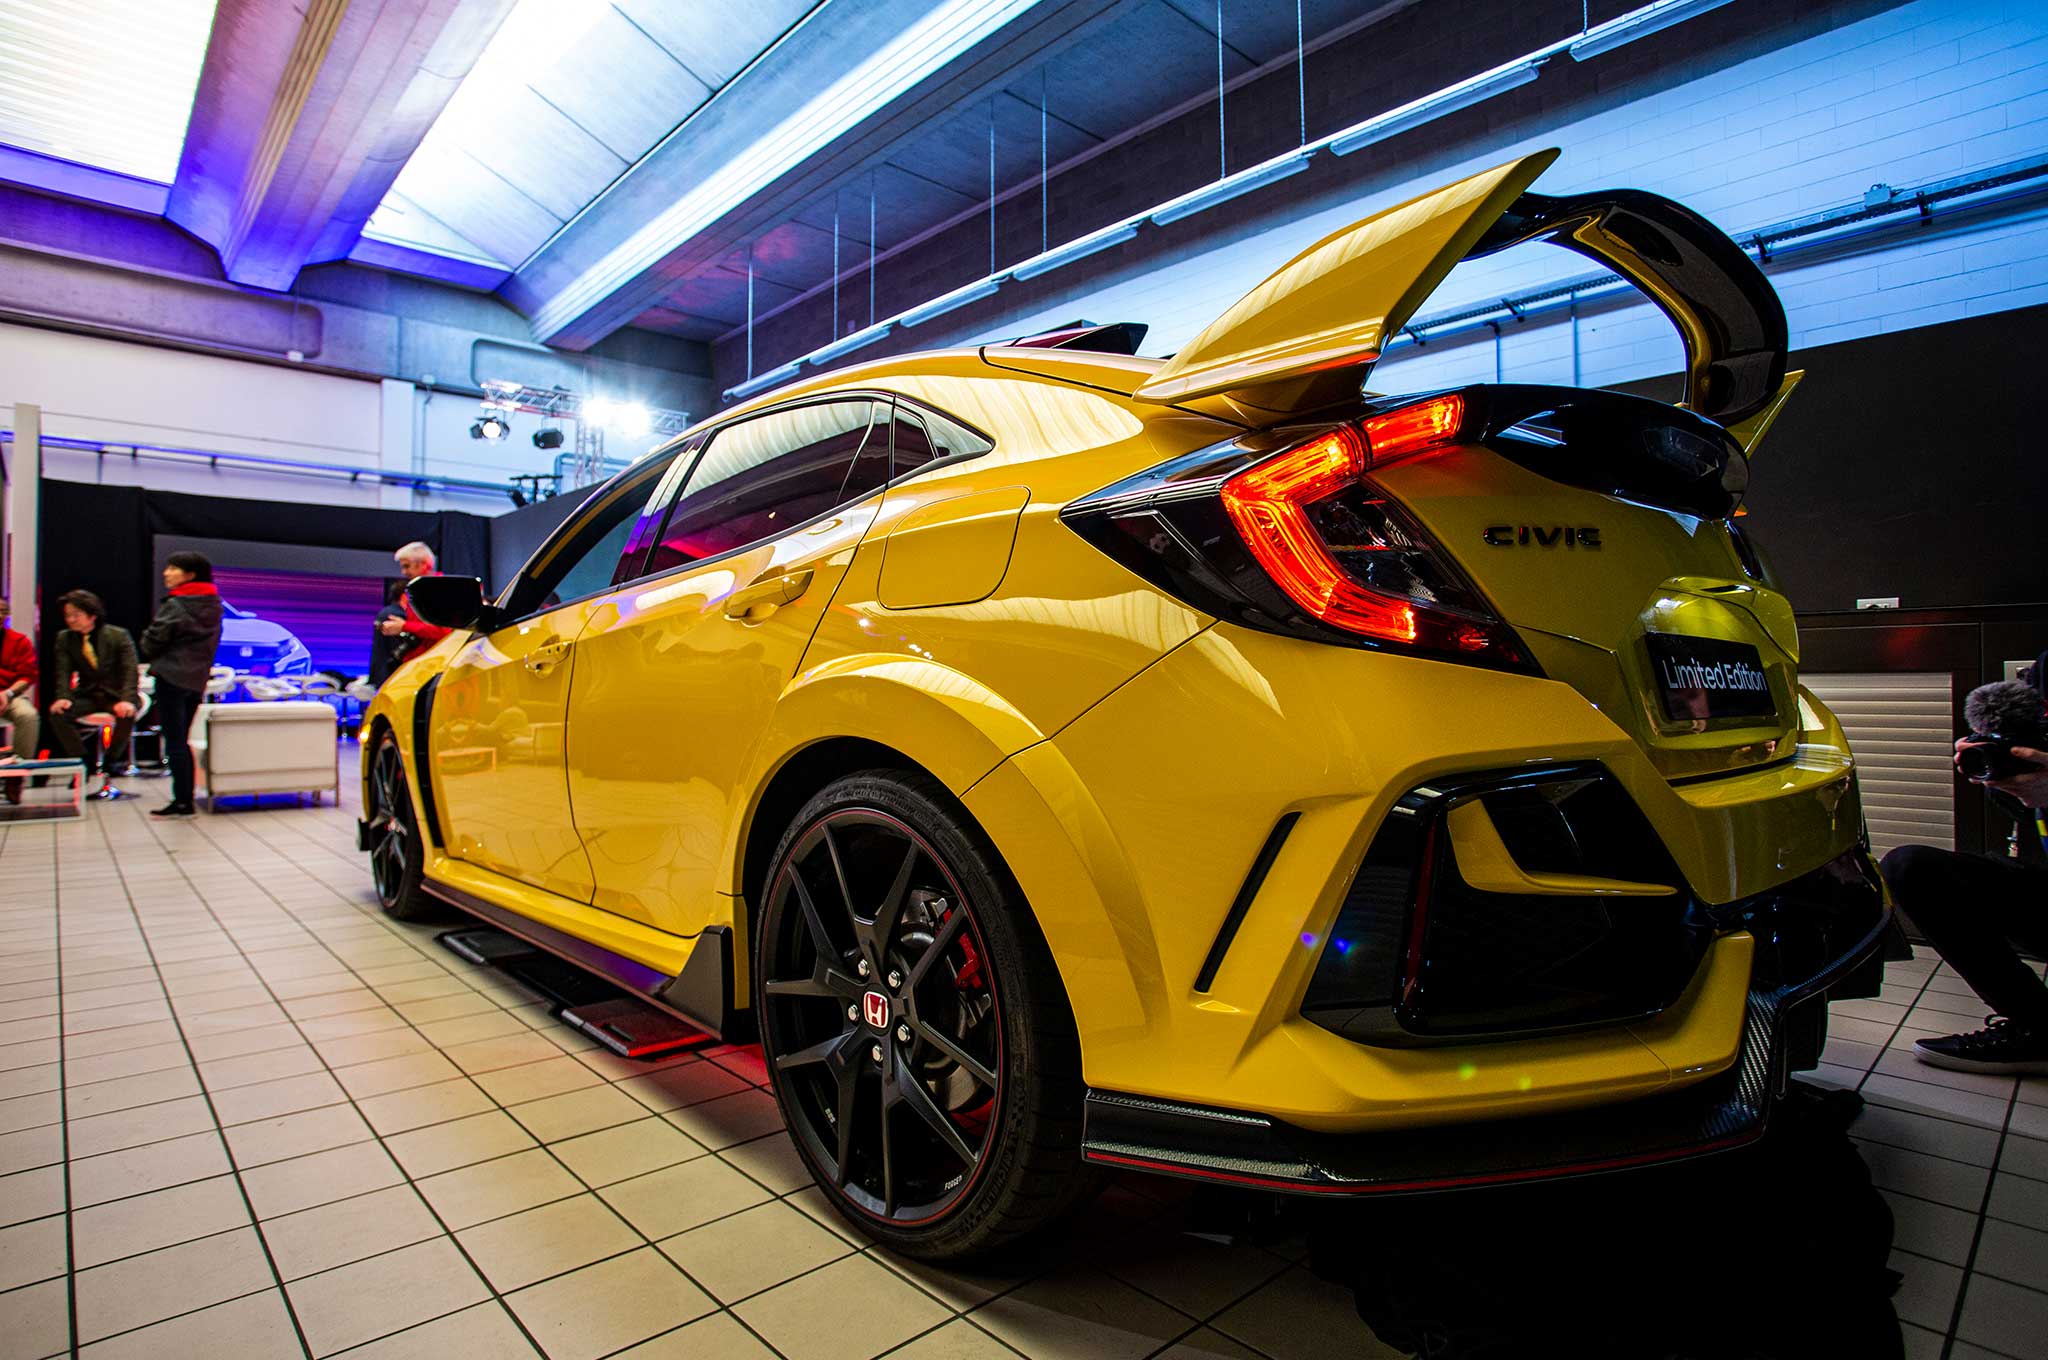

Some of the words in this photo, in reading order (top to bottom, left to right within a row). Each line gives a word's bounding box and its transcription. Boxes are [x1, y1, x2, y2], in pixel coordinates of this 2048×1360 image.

[1482, 526, 1602, 546] CIVIC
[1661, 655, 1726, 690] Limited
[1723, 660, 1768, 691] Edition
